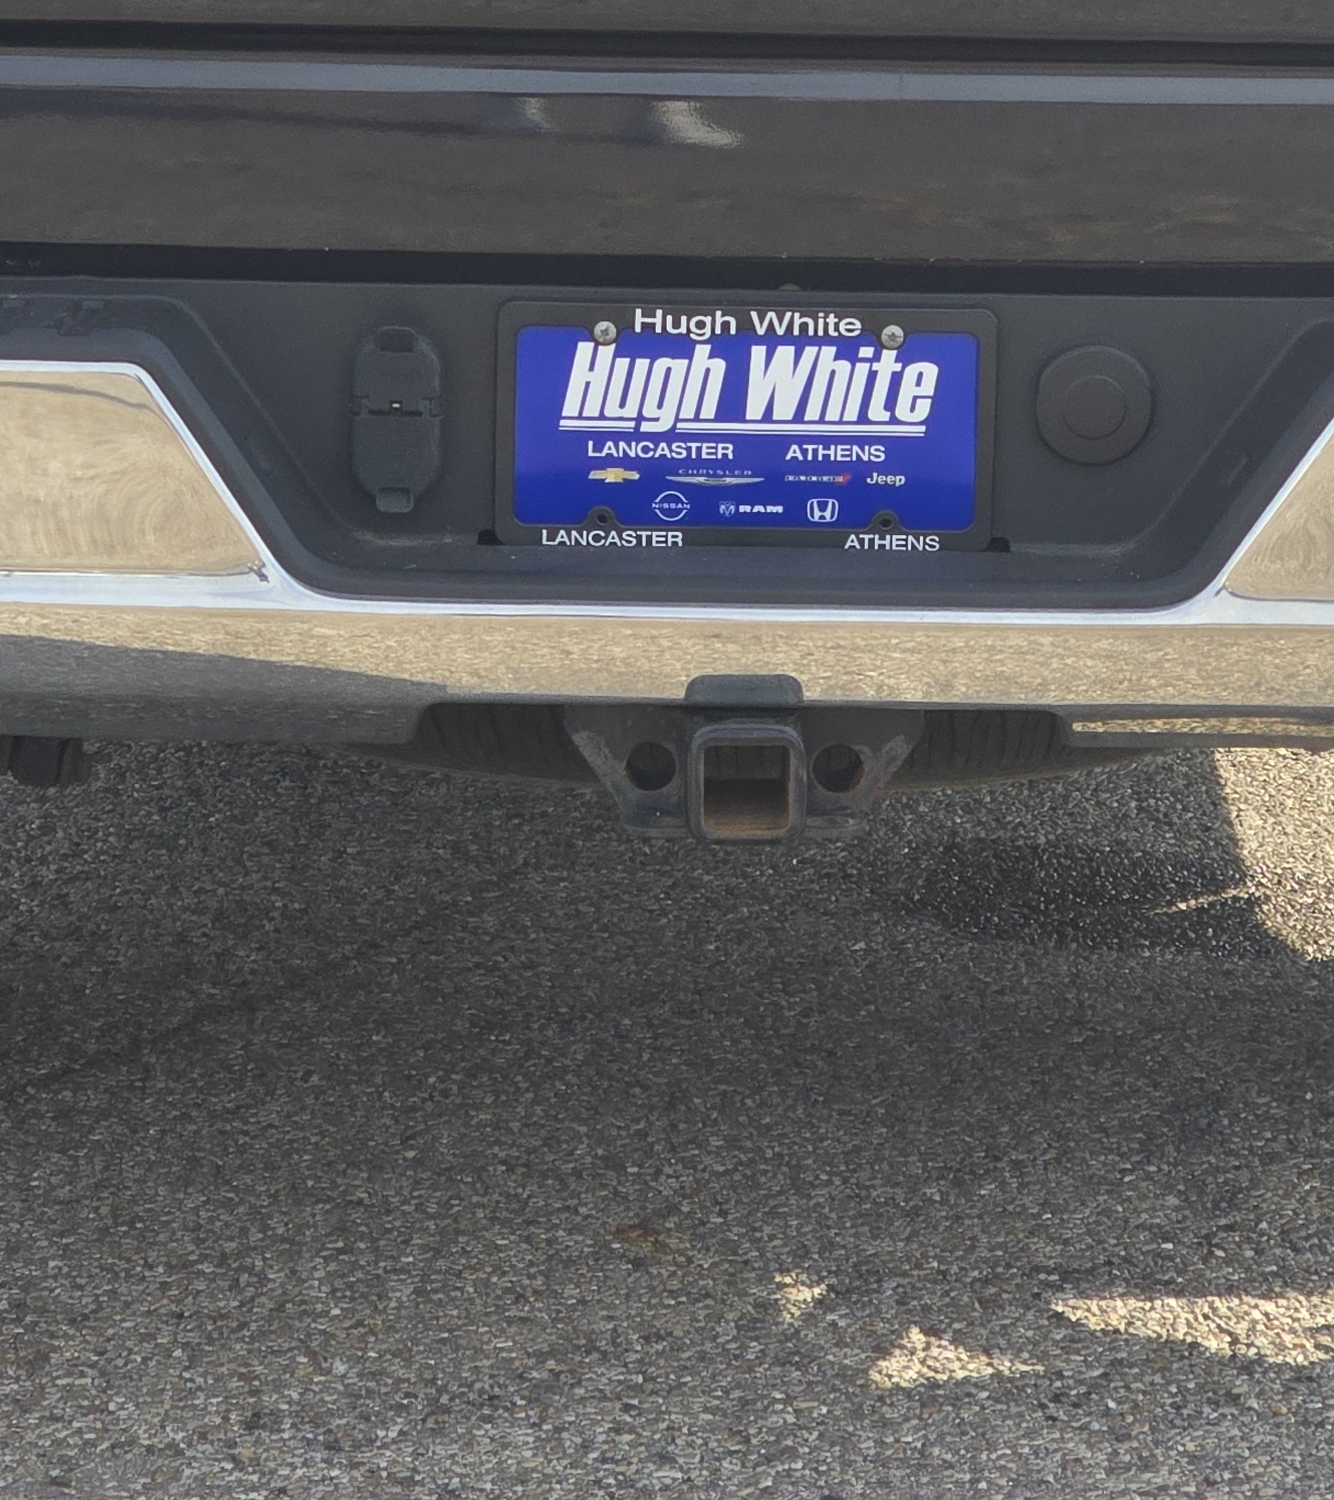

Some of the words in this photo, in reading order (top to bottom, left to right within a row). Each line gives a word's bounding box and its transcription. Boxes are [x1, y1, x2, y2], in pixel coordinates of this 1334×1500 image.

[633, 308, 738, 341] Hugh
[750, 310, 863, 338] White
[561, 340, 728, 433] Hugh
[745, 345, 940, 423] White
[587, 440, 734, 460] LANCASTER
[785, 444, 887, 462] ATHENS
[678, 468, 754, 476] CHRYSLER
[866, 472, 906, 487] Jeep
[651, 501, 691, 510] NISSAN
[738, 504, 784, 514] RAM
[540, 529, 684, 548] LANCASTER
[844, 533, 941, 552] ATHENS
